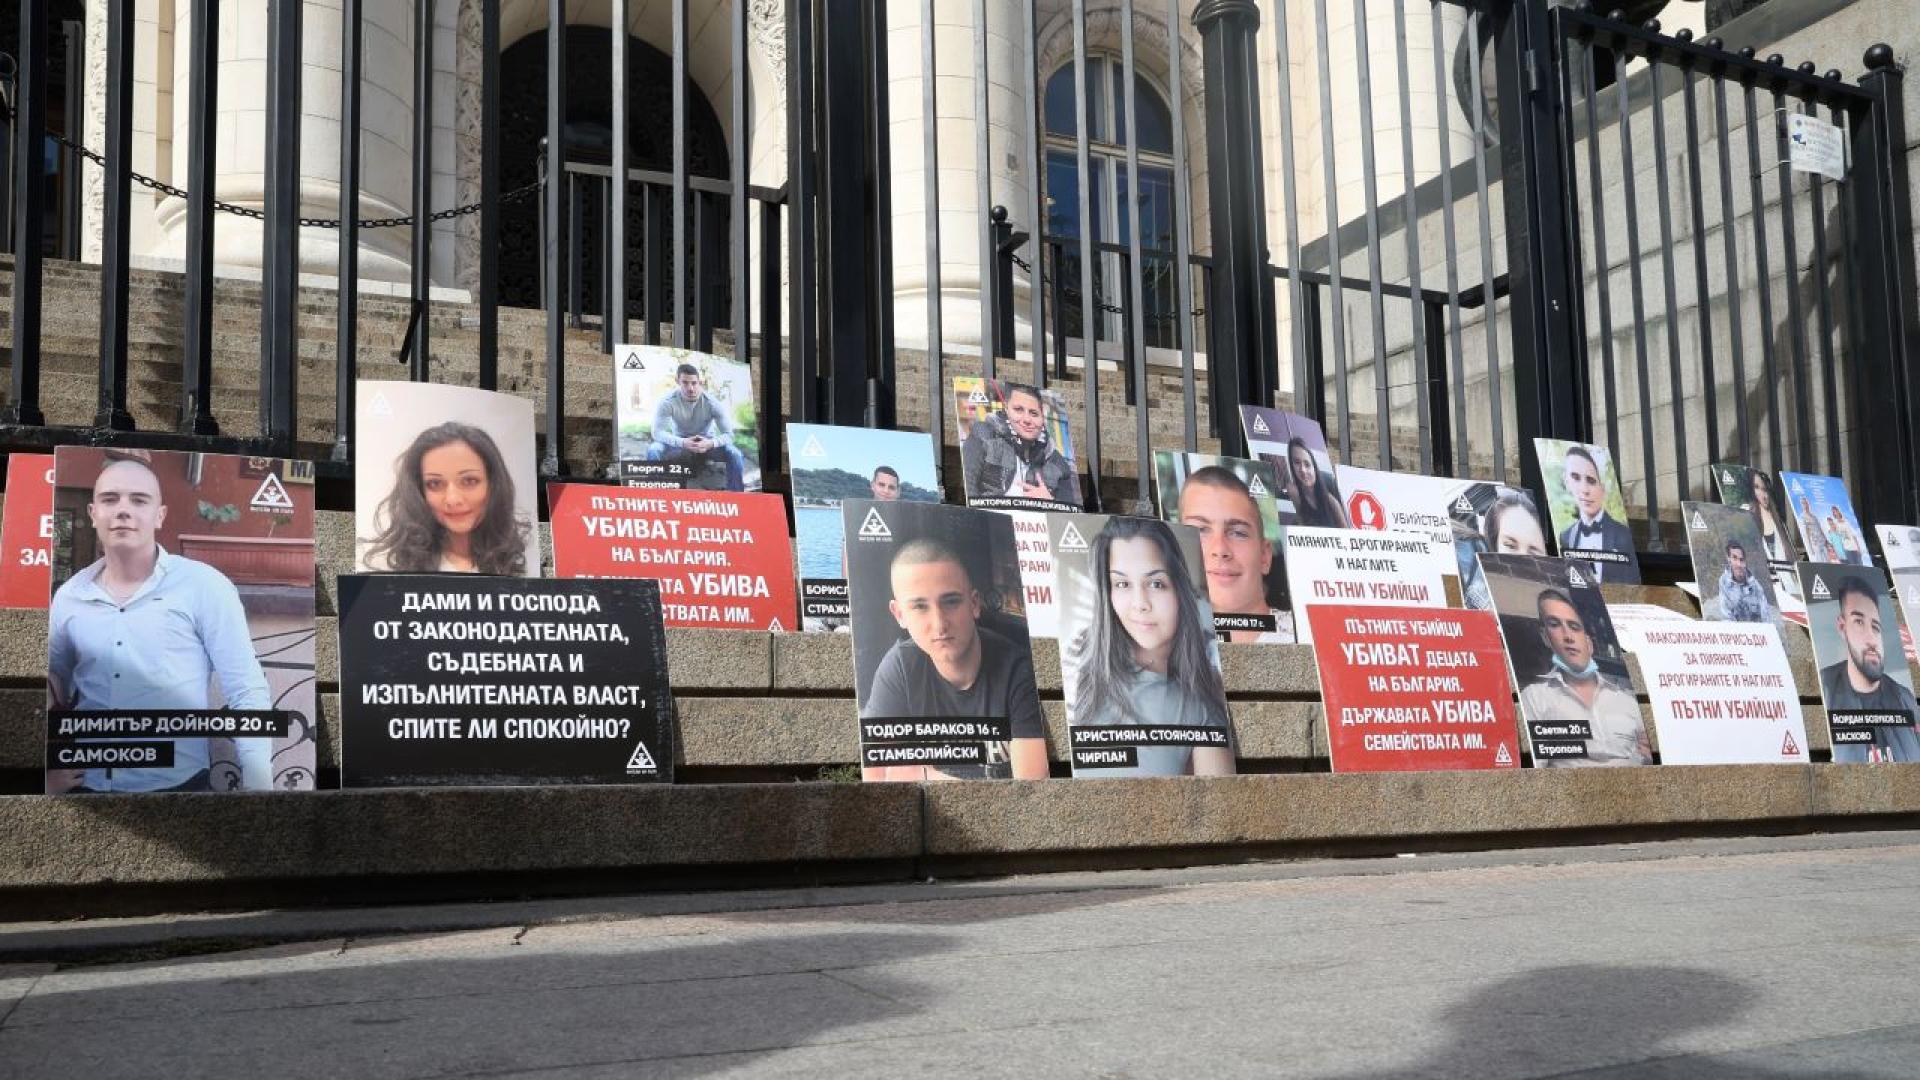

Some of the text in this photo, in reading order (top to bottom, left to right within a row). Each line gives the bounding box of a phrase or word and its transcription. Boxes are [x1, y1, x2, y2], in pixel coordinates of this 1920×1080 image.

[669, 465, 682, 474] 22
[592, 496, 739, 518] ПЪТНИТЕ УБИЙЦИ
[583, 516, 754, 544] УБИВАТ ДЕЦАТА
[1288, 535, 1431, 555] ПИЯНИТЕ, ДРОГИРАНИТЕ
[612, 547, 732, 567] НА БЪЛГАРИЯ.
[1335, 557, 1399, 572] И НАГЛИТЕ
[688, 572, 770, 598] УБИВА
[1313, 580, 1429, 603] ПЪТНИ УБИЙЦИ
[401, 592, 601, 615] ДАМИ И ГОСПОДА
[724, 606, 755, 623] ИМ.
[373, 621, 630, 646] ОТ ЗАКОНОДАТЕЛНАТА,
[1344, 617, 1464, 638] ПЪТНИТЕ УБИЙЦИ
[1645, 631, 1768, 648] МАКСИМАЛНИ ПРИСЪДИ
[427, 652, 584, 675] СЪДЕБНАТА И
[1340, 642, 1479, 668] УБИВАТ ДЕЦАТА
[1683, 652, 1748, 667] ЗА ПИЯНИТЕ,
[1367, 675, 1464, 693] НА БЪЛГАРИЯ.
[1658, 674, 1785, 688] ДРОГИРАНИТЕ И НАГЛИТЕ
[362, 684, 647, 709] ИЗПЪЛНИТЕЛНАТА ВЛАСТ,
[1341, 699, 1497, 727] ДЪРЖАВАТА УБИВА
[1671, 697, 1788, 722] ПЪТНИ УБИЙЦИ!
[58, 713, 277, 735] ДИМИТЪР ДОЙНОВ 20 г.
[388, 713, 631, 739] СПИТЕ ЛИ СПОКОЙНО?
[865, 723, 1000, 738] ТОДОР БАРАКОВ 16 г.
[1568, 724, 1580, 735] 20
[1074, 727, 1148, 743] ХРИСТИЯНА
[1150, 729, 1208, 742] СТОЯНОВА
[1364, 729, 1487, 751] СЕМЕЙСТВАТА ИМ.
[1835, 731, 1873, 742] ХАСКОВО
[58, 747, 157, 764] САМОКОВ
[867, 745, 979, 762] СТАМБОЛИЙСКИ
[1076, 751, 1127, 764] ЧИРПАН
